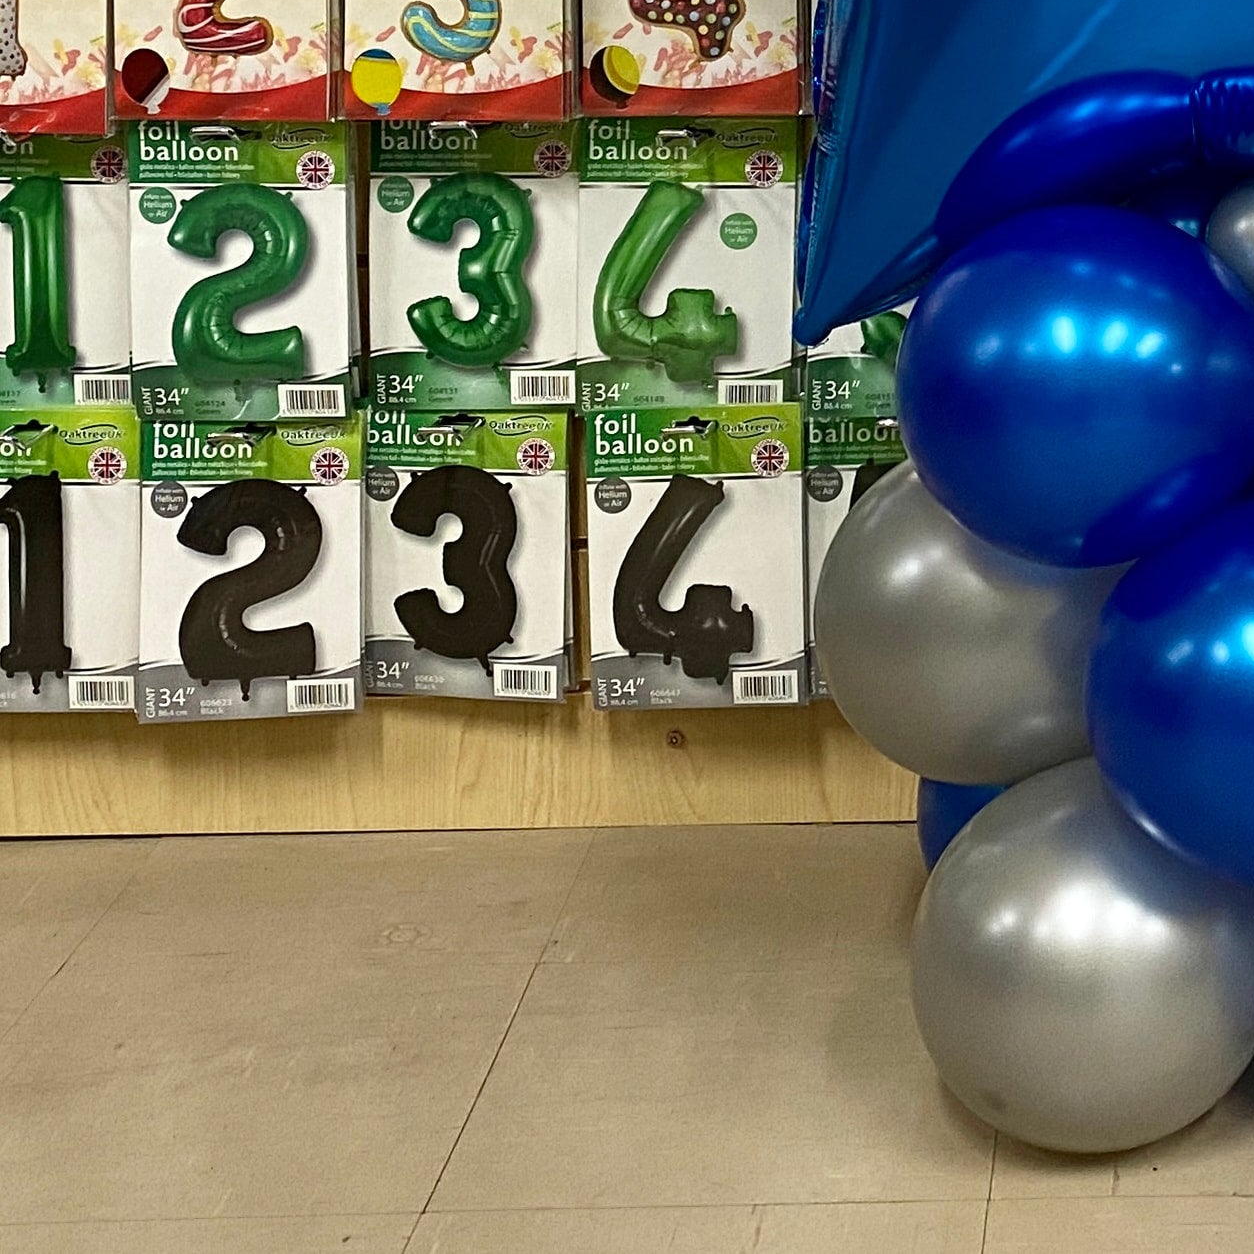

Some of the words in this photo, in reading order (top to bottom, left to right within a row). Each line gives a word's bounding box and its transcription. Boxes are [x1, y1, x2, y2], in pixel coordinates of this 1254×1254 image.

[139, 121, 179, 142] foil
[139, 141, 239, 161] balloon
[143, 387, 153, 415] GIANT
[154, 387, 189, 407] 34"
[594, 414, 636, 436] foil
[153, 438, 252, 460] balloon
[595, 435, 694, 455] balloon
[146, 687, 156, 719] GIANT
[158, 688, 195, 708] 34"
